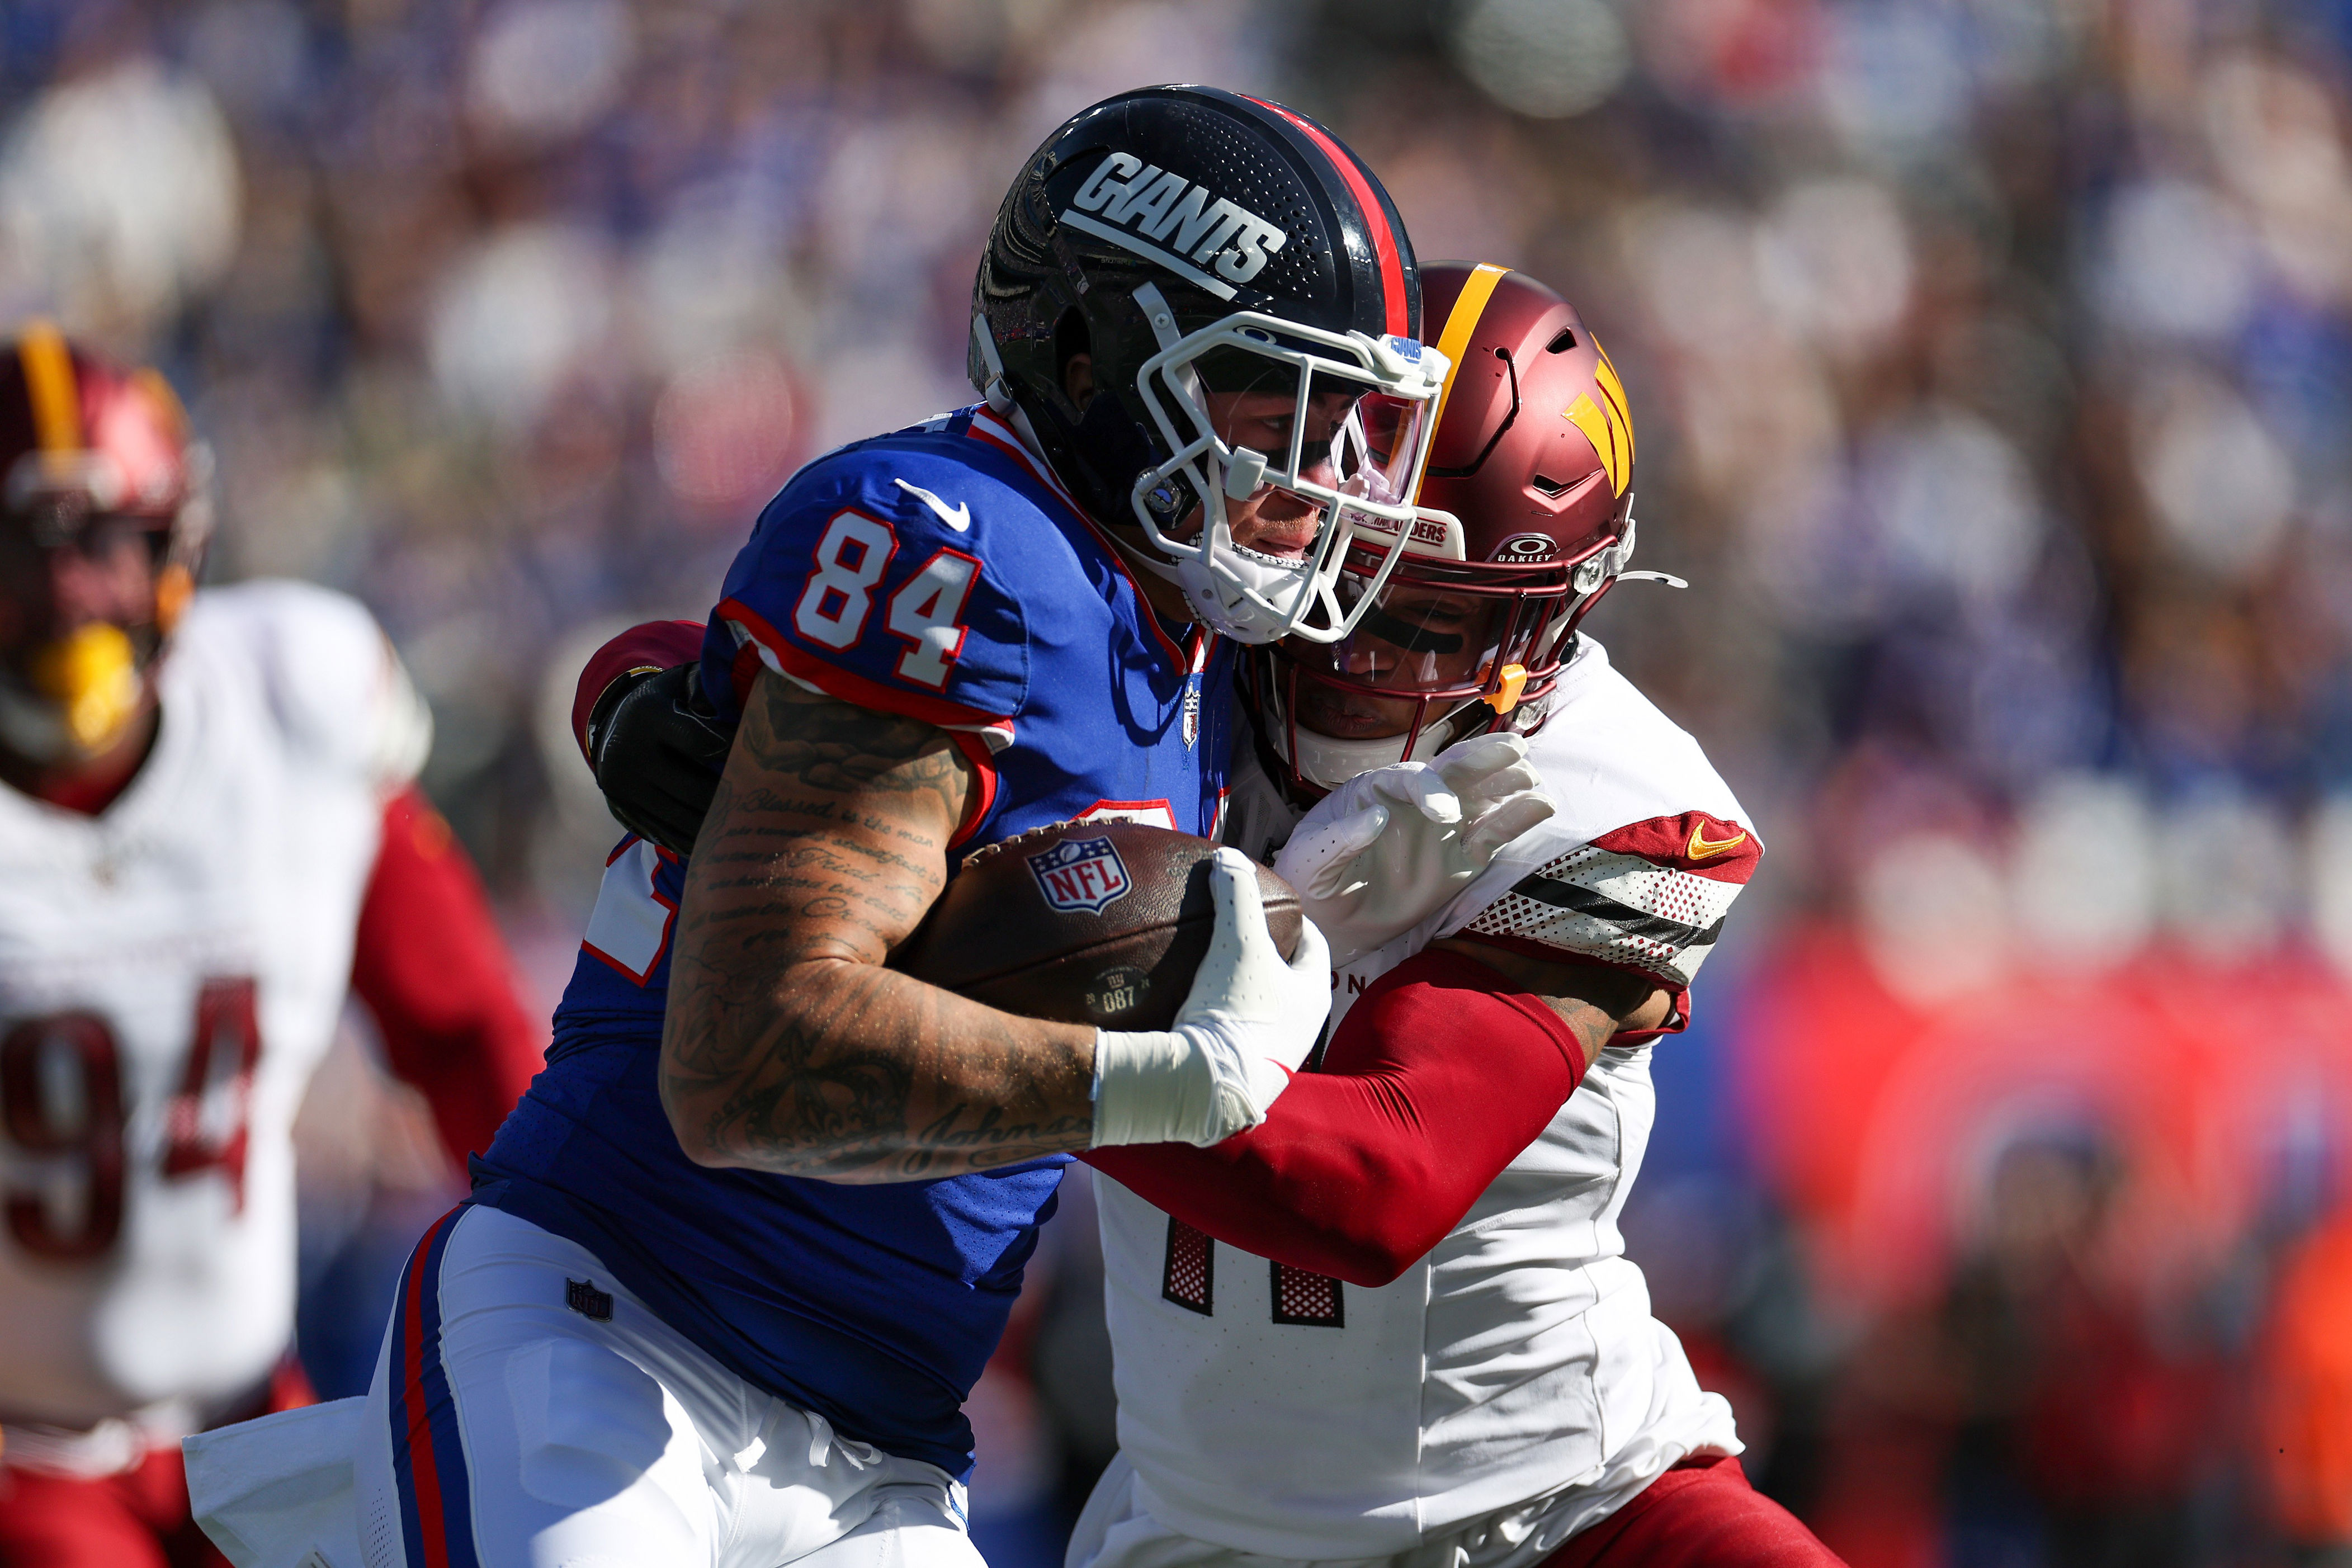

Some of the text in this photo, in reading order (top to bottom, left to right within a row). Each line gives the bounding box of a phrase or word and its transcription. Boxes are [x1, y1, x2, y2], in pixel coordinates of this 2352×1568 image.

[1073, 152, 1286, 284] GIANTS
[1391, 338, 1421, 360] GIANTS
[791, 506, 983, 693] 84
[896, 829, 933, 848] man
[1046, 859, 1121, 901] NFL
[1102, 985, 1135, 1013] 087
[0, 974, 263, 1265] 94
